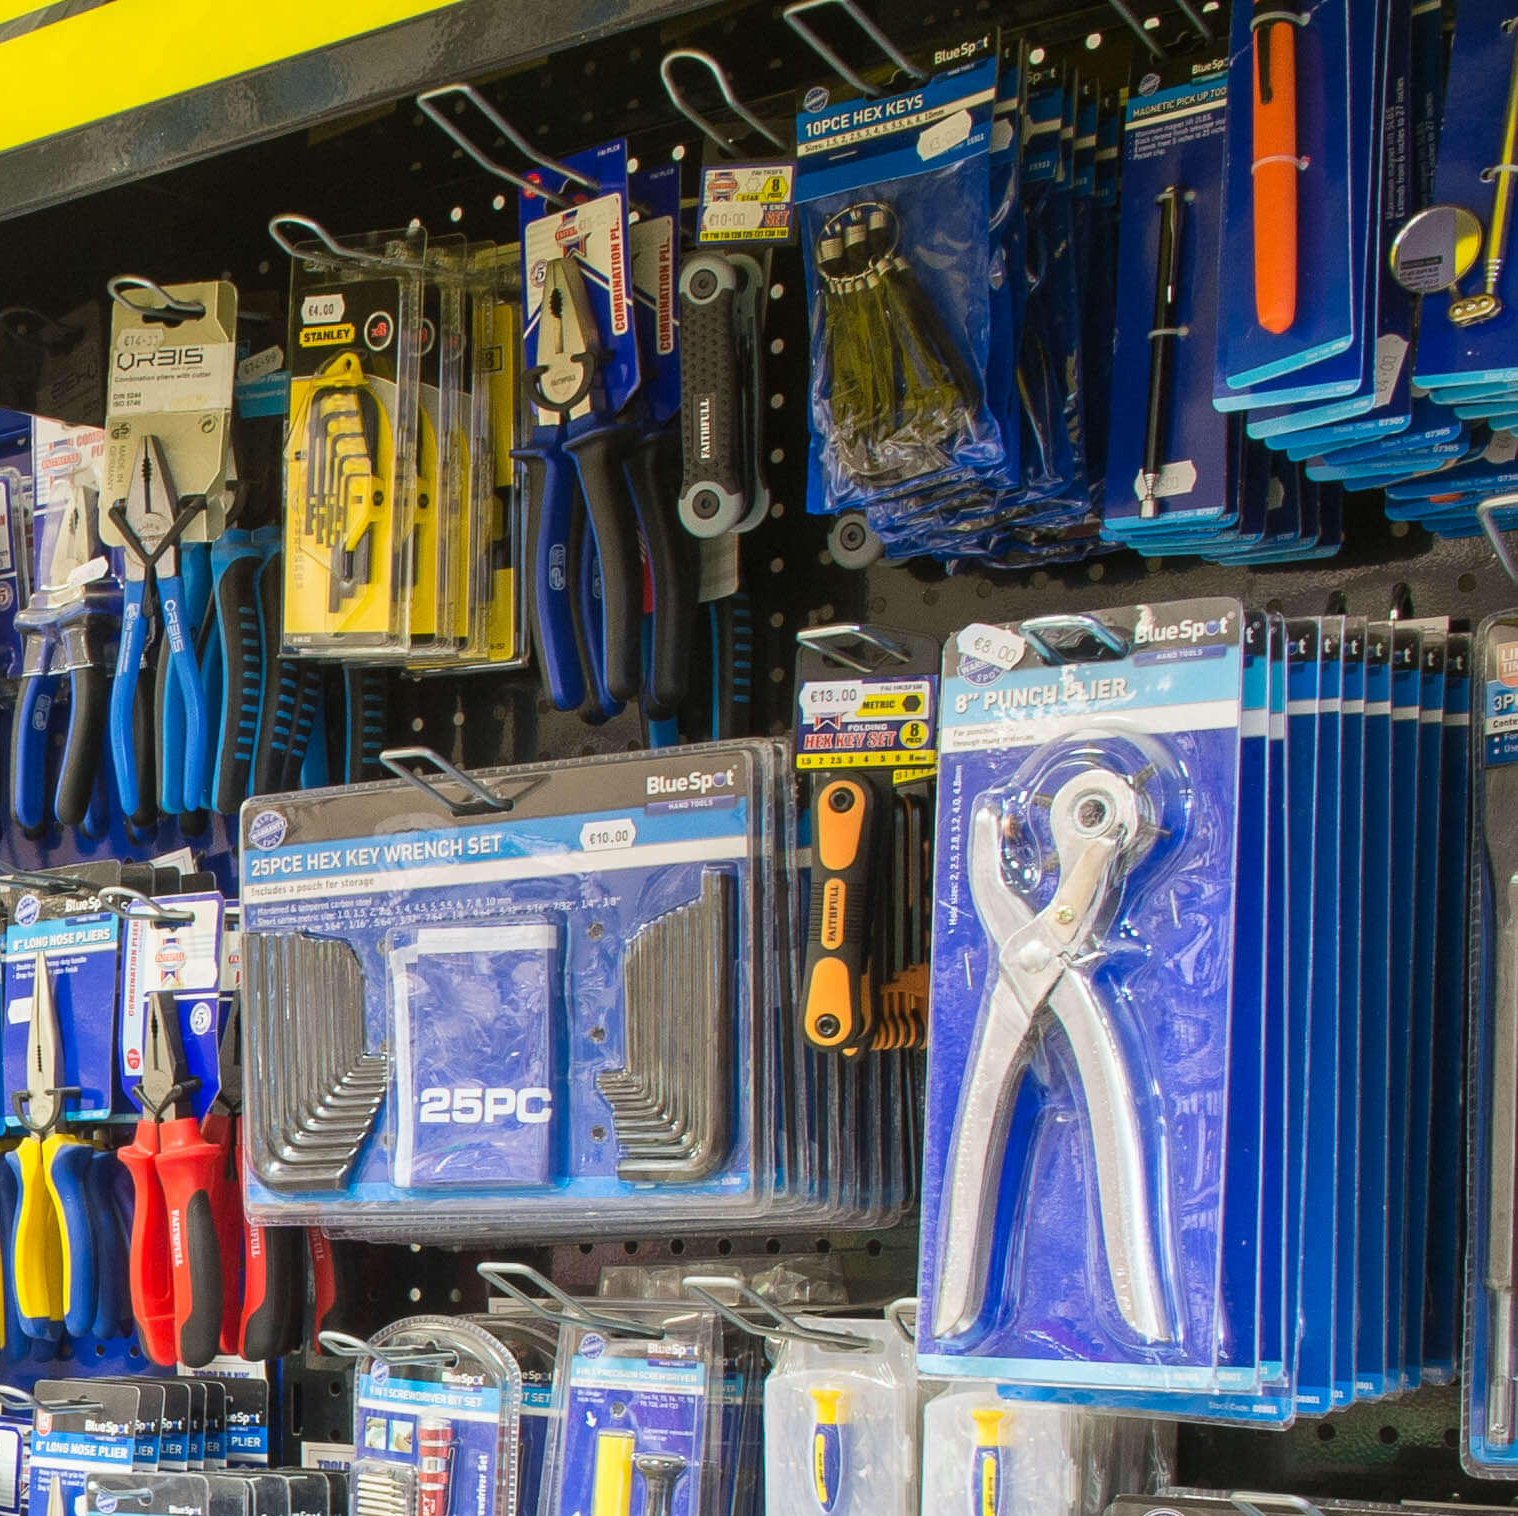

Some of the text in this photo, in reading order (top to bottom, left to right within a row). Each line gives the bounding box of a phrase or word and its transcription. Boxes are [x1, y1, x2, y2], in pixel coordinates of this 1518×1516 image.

[934, 36, 989, 64] BlueSpot
[1133, 86, 1228, 118] MAGNETIC PICK UP TOO
[805, 113, 850, 137] 10PCE
[853, 101, 882, 125] HEX
[885, 94, 923, 116] KEYS
[610, 245, 626, 331] COMBINATION
[308, 304, 334, 316] €4.00
[303, 328, 350, 342] STANLEY
[115, 375, 155, 383] Combination
[157, 374, 175, 382] pliers
[701, 398, 711, 461] FAITHFULL
[1134, 619, 1229, 645] BlueSpot
[974, 636, 1017, 664] €8.00
[1156, 649, 1203, 660] HAND TOOLS
[810, 687, 858, 705] €13.00
[862, 698, 896, 711] METRIC
[983, 678, 1127, 712] PUNCH PLIER
[847, 722, 888, 732] FOLDING
[803, 731, 897, 750] HEX KEY SET
[646, 771, 736, 795] BlueSpot
[668, 798, 714, 810] HAND TOOLS
[589, 830, 629, 845] €10.00
[251, 834, 502, 878] 25PCE HEX KEY WRENCH SET
[251, 876, 375, 898] Includes pouch for storage
[828, 885, 840, 943] FAITHFULL
[25, 928, 111, 949] LONG NOSE PLIERS
[419, 1088, 552, 1124] 25PC
[84, 1420, 131, 1434] BlueSpot
[50, 1441, 128, 1459] LONG NOSE PLIER
[477, 1455, 488, 1471] Set
